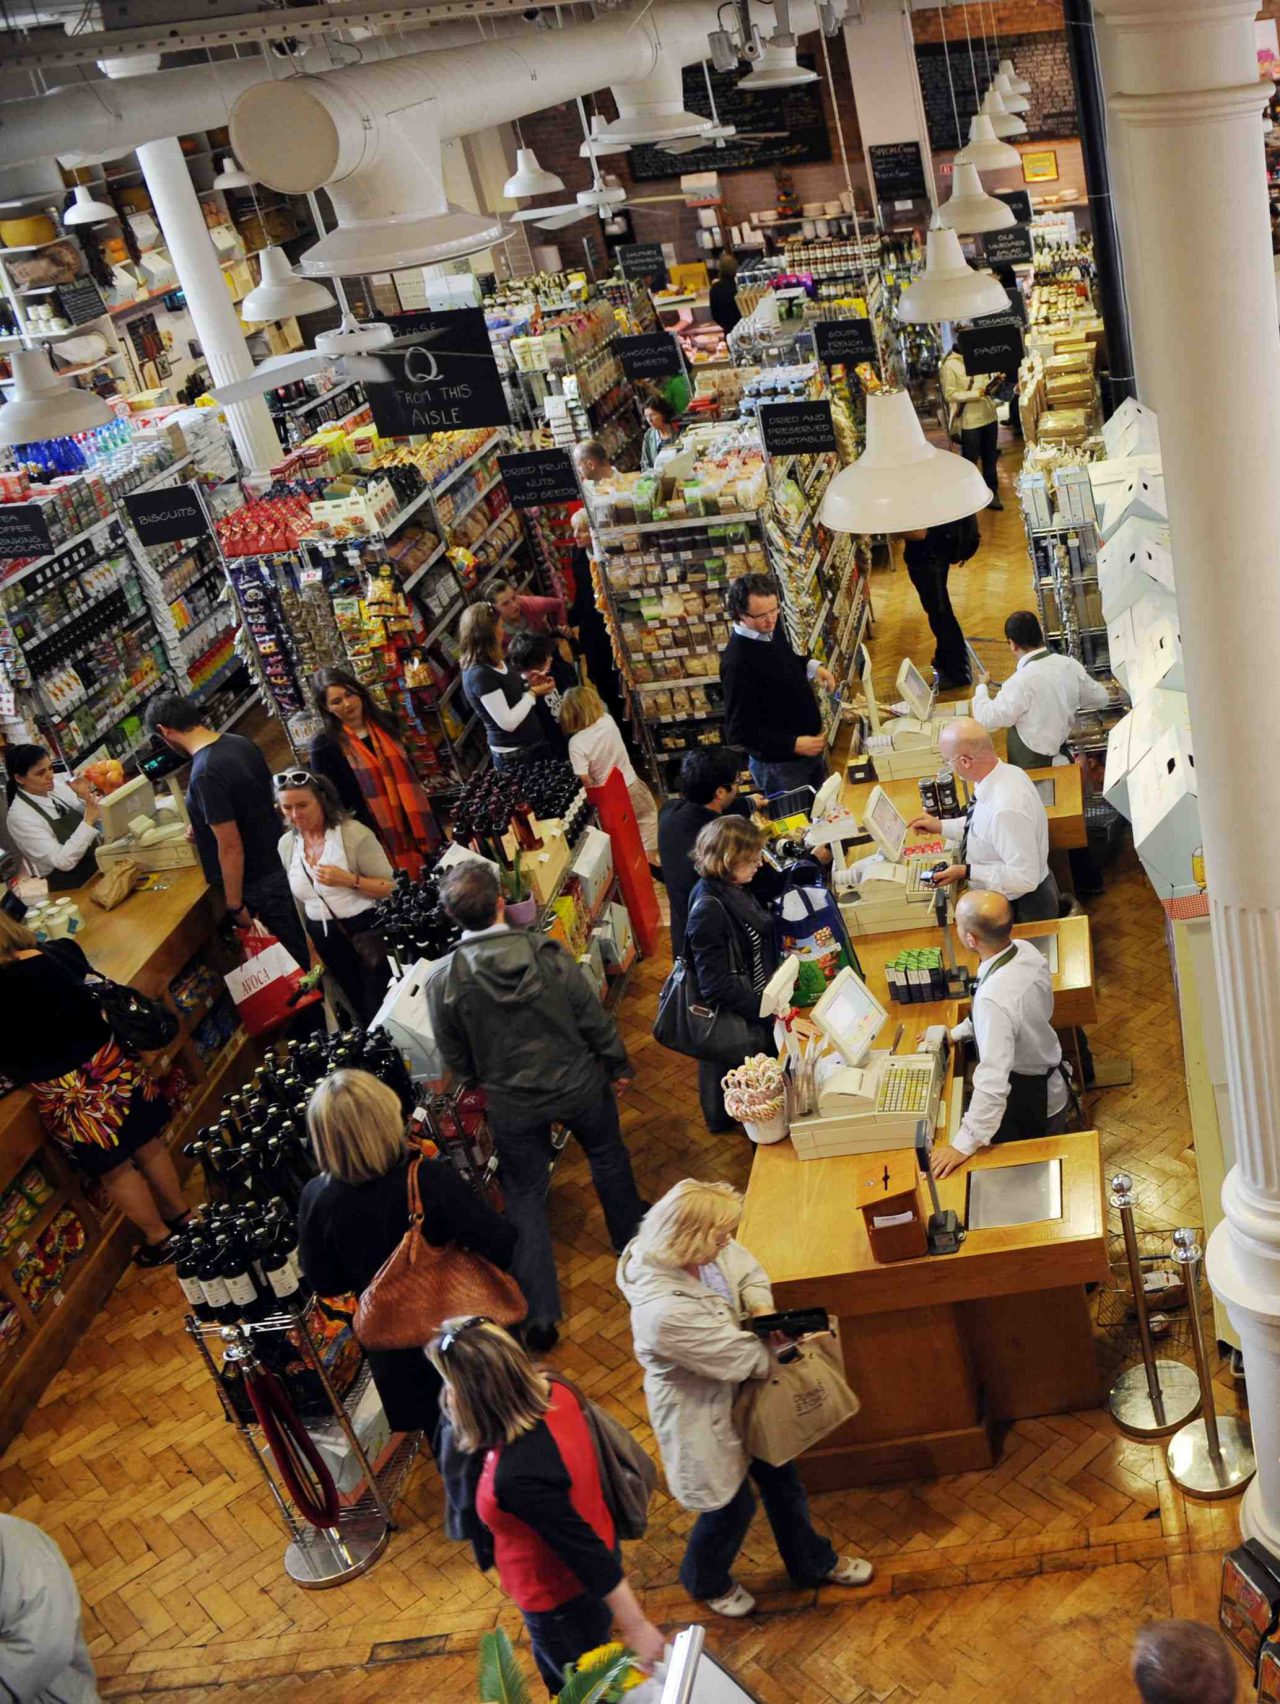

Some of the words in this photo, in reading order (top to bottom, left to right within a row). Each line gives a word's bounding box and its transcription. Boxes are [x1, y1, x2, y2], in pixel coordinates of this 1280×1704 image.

[977, 316, 1023, 327] TOMATOES
[621, 344, 675, 358] CHOCOLATE
[974, 345, 1012, 356] PASTA
[404, 346, 444, 383] Q
[632, 357, 669, 369] SWEETS
[396, 390, 432, 404] FROM
[439, 384, 473, 399] THIS
[412, 408, 462, 426] AISLE
[769, 416, 799, 425] DRIED
[802, 413, 826, 422] AND
[768, 425, 831, 436] PRESERVED
[767, 434, 835, 446] VEGETABLES
[503, 465, 536, 477] DRIED
[526, 478, 555, 488] NUTS
[513, 492, 538, 501] AND
[541, 487, 578, 499] SEEDS
[137, 506, 197, 526] BISCUITS
[241, 967, 271, 996] AVOCA
